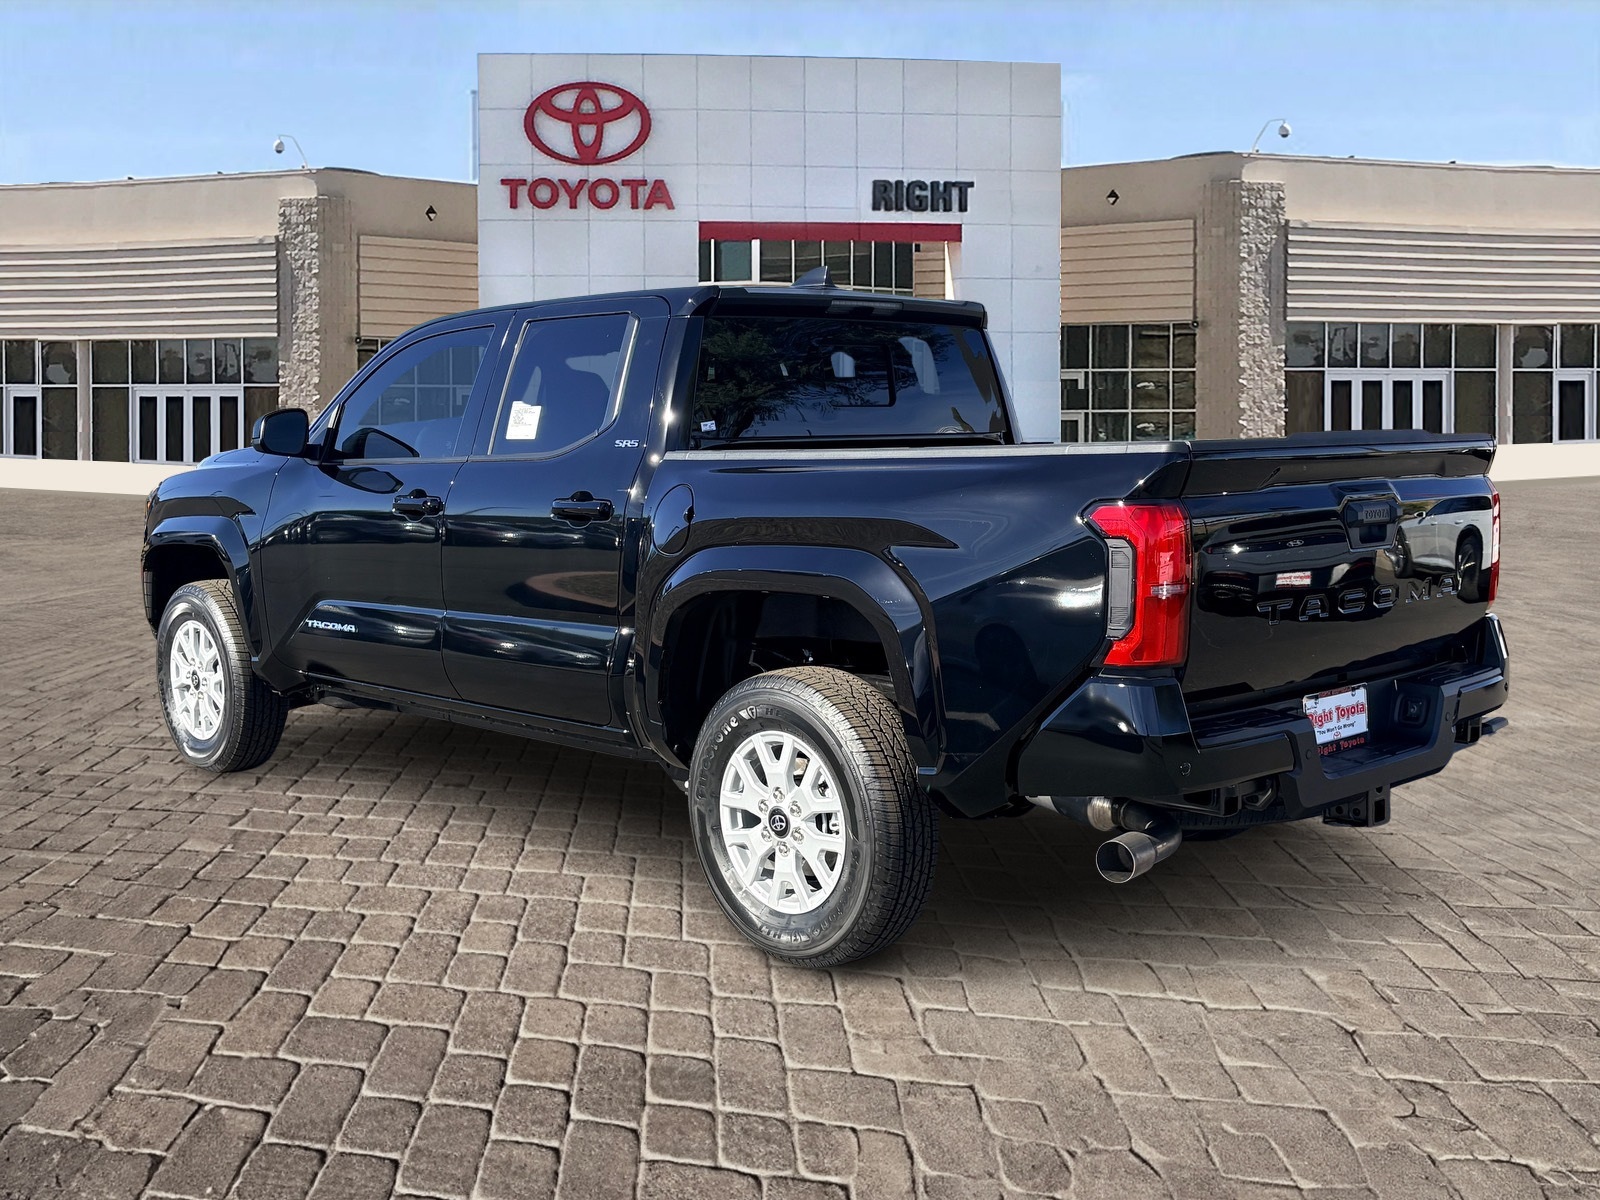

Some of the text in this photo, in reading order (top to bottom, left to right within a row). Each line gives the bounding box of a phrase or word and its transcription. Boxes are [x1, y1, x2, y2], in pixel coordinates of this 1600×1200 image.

[501, 178, 675, 210] TOYOTA
[871, 179, 975, 213] RIGHT
[614, 439, 640, 448] SR5
[1364, 509, 1390, 520] TOYOTA
[1257, 573, 1459, 626] TACOMA
[306, 620, 356, 632] TACOMA
[1335, 701, 1366, 722] Toyota
[1340, 737, 1365, 749] Toyota
